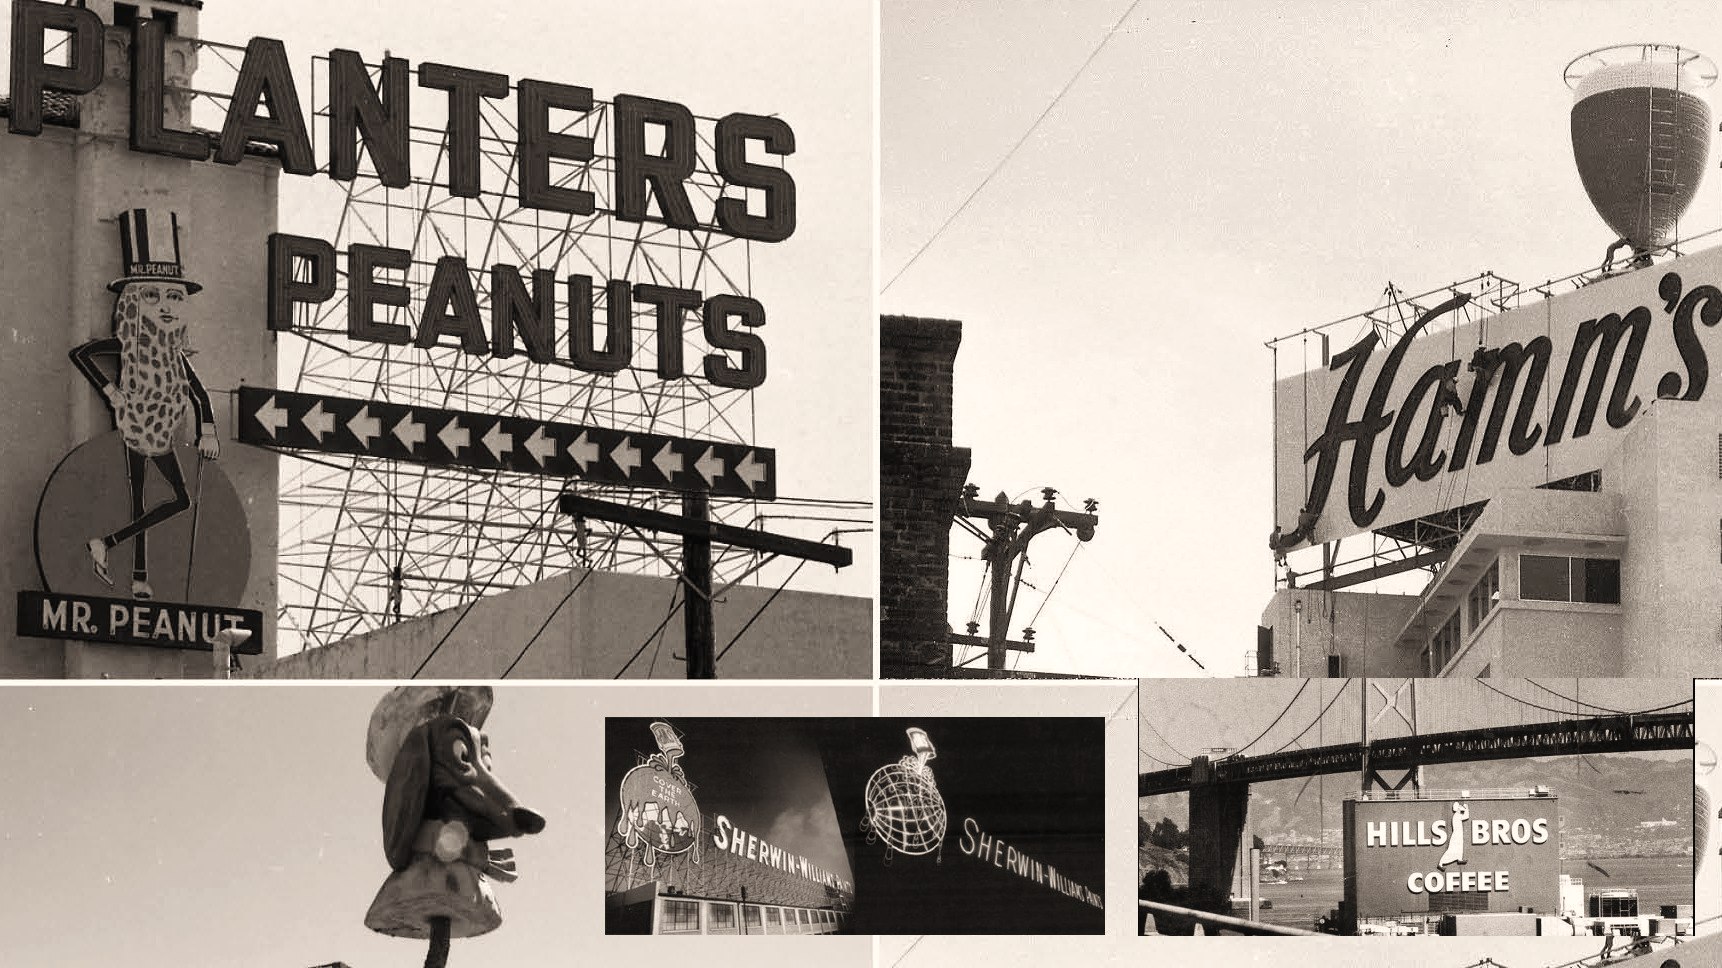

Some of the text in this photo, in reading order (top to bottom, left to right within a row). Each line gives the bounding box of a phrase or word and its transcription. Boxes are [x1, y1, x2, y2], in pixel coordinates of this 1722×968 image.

[8, 0, 797, 243] PLANTERS
[267, 232, 767, 390] PEANUTS
[1270, 271, 1722, 549] Hamm's
[43, 599, 245, 645] MR. PEANUT
[651, 789, 680, 807] EARTH
[653, 775, 682, 795] COVER
[659, 785, 676, 799] THE
[1367, 818, 1549, 847] HILLS BROS
[1407, 870, 1510, 894] COFFEE
